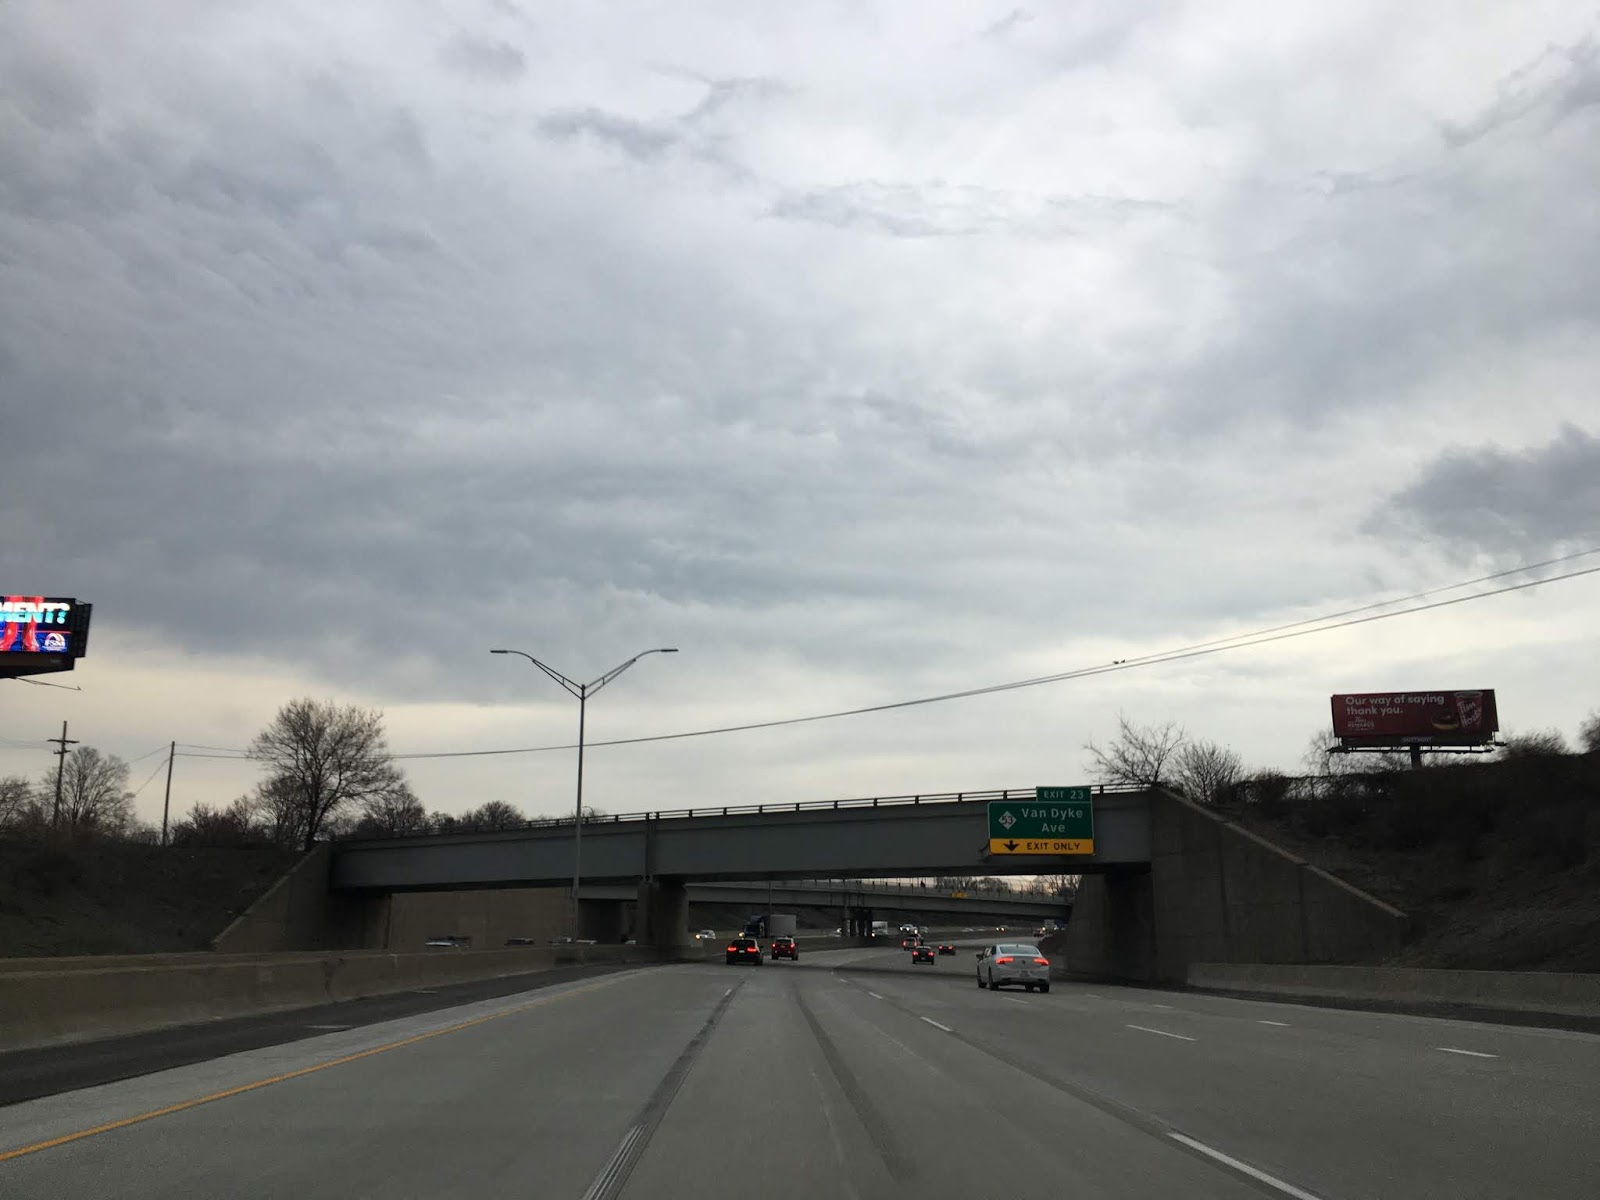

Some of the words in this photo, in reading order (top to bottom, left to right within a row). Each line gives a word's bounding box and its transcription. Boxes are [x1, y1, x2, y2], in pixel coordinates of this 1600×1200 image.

[1345, 696, 1367, 705] Our
[1369, 696, 1391, 706] way
[1394, 694, 1405, 704] of
[1407, 693, 1445, 706] saying
[1346, 705, 1377, 715] thank
[1380, 707, 1403, 717] you.
[1043, 790, 1065, 799] EXIT
[1070, 790, 1084, 799] 23
[1021, 808, 1047, 818] Van
[1051, 808, 1083, 820] Dyke
[1041, 823, 1066, 833] Ave
[1026, 842, 1049, 851] EXIT
[1053, 842, 1080, 851] ONLY
